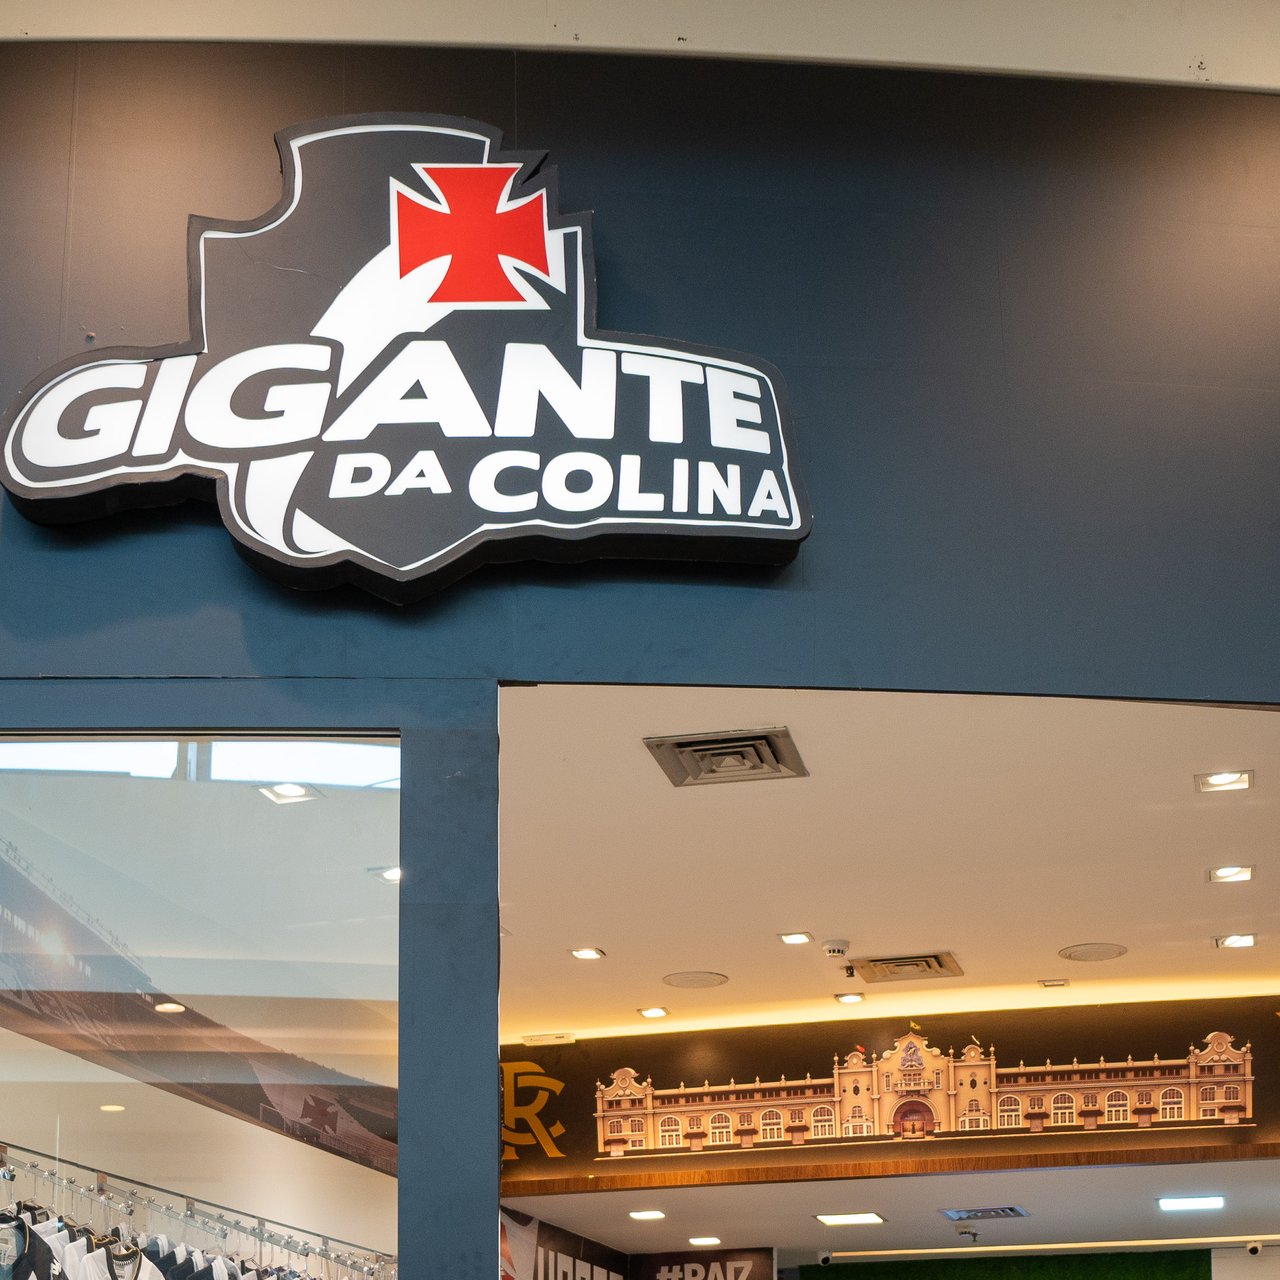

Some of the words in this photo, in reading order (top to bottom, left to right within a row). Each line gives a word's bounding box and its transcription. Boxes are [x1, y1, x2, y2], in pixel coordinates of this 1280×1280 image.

[20, 340, 772, 470] GIGANTE
[328, 449, 452, 499] DA
[468, 450, 790, 521] COLINA
